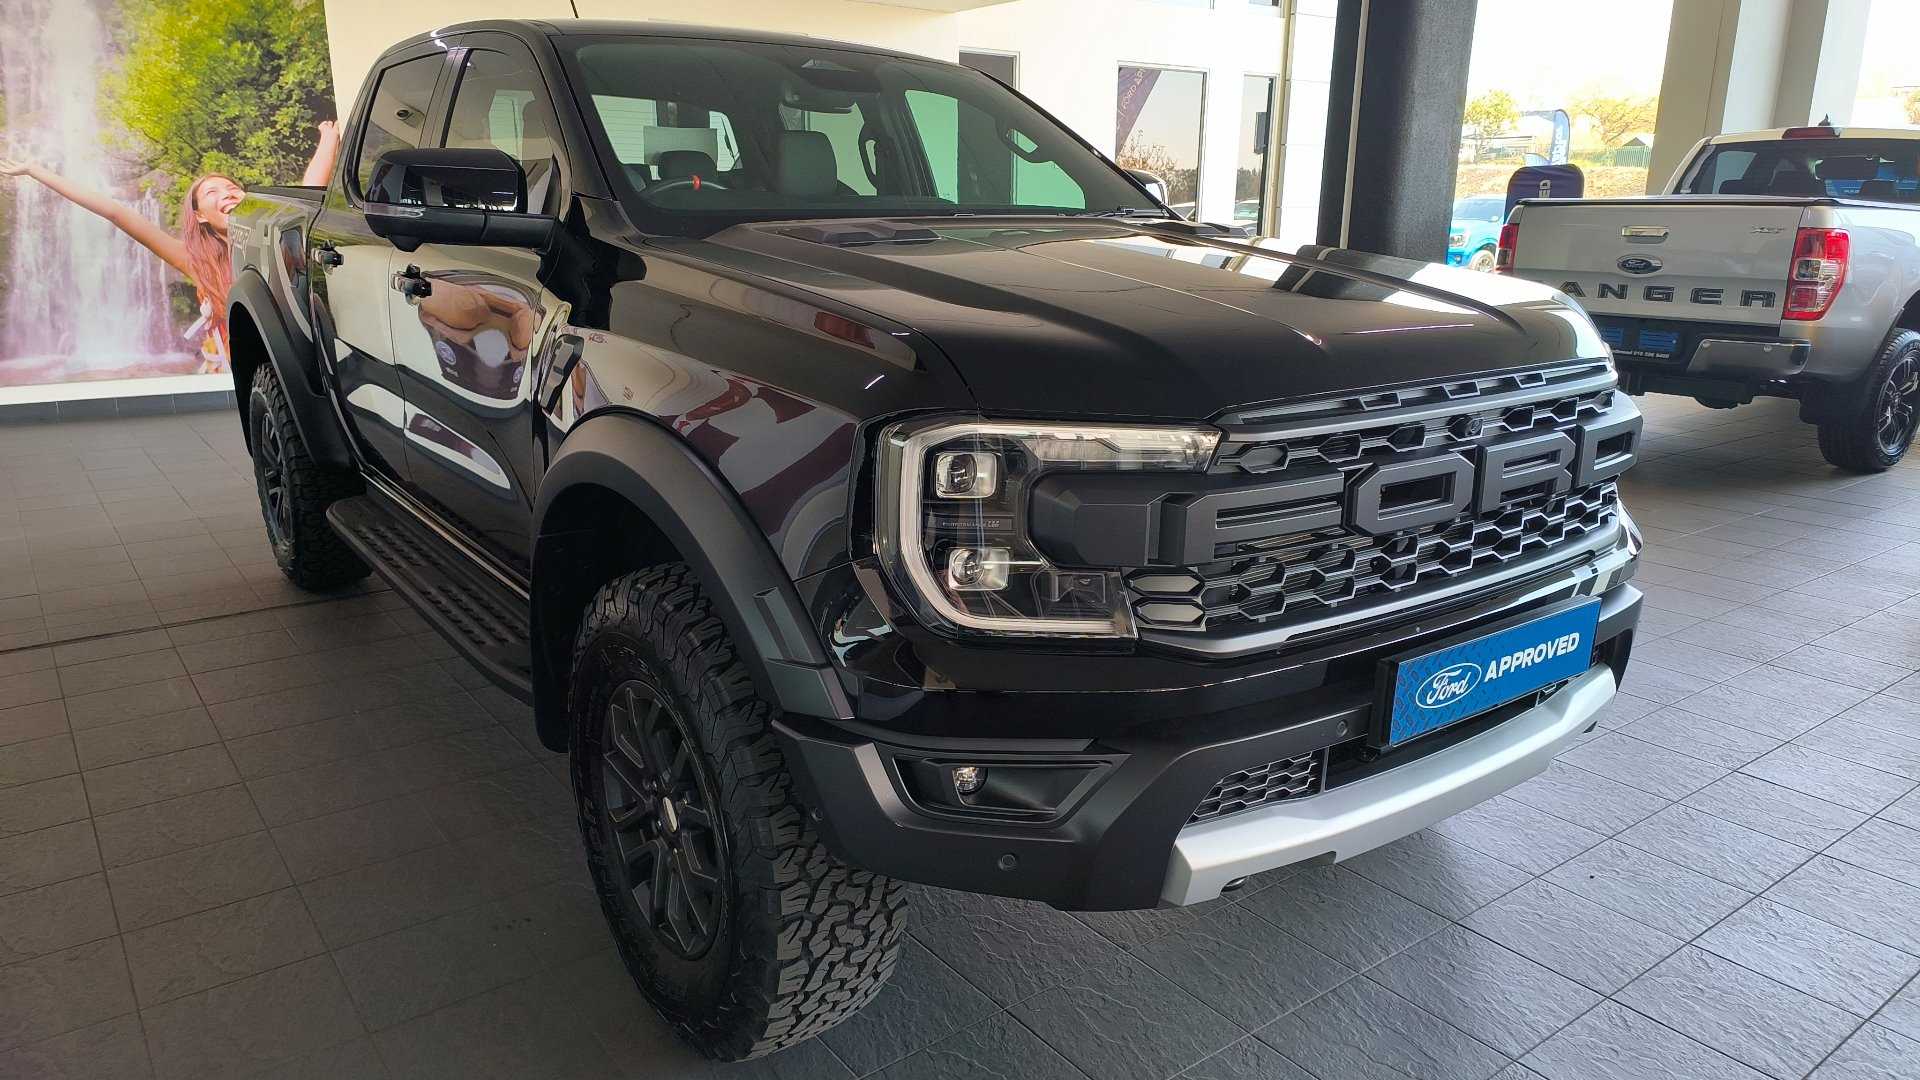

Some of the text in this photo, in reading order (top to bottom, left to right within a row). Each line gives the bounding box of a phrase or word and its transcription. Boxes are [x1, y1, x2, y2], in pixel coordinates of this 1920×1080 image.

[1560, 281, 1777, 308] ANGER
[1180, 415, 1643, 566] FORD
[1426, 632, 1580, 705] Ford APPROVED
